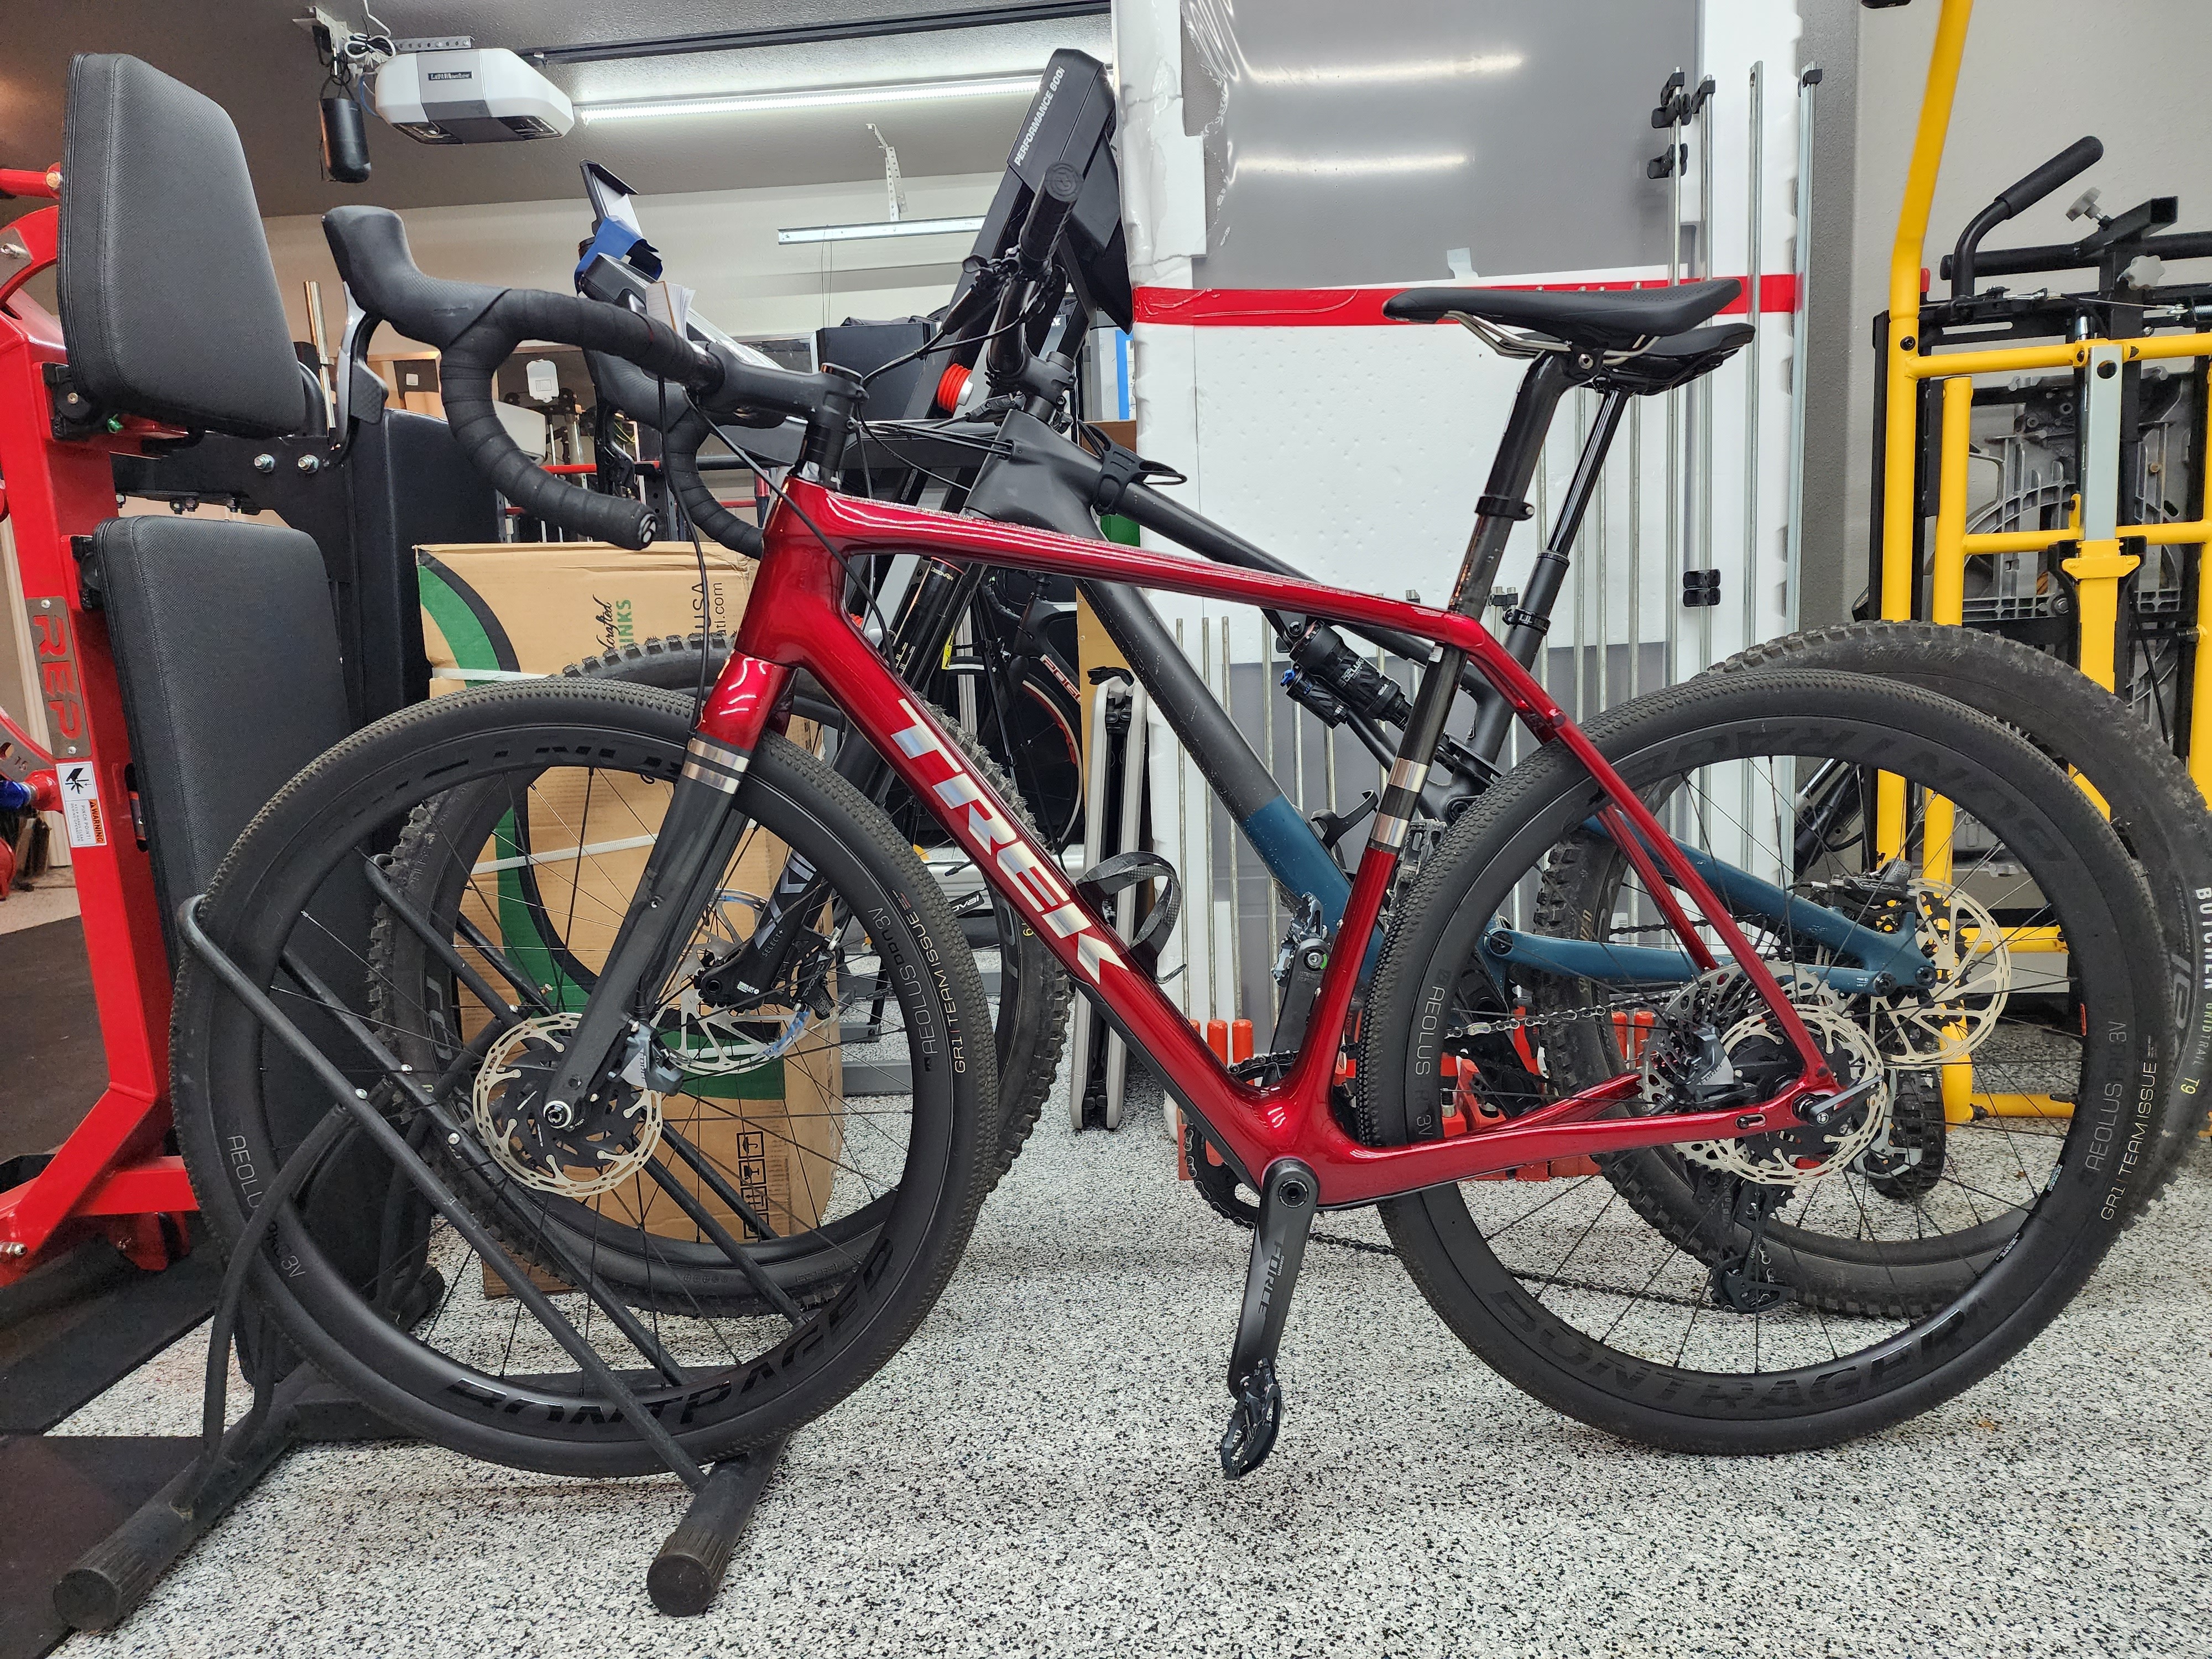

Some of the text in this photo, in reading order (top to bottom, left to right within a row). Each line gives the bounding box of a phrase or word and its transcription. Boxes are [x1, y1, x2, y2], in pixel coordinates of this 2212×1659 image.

[1014, 66, 1066, 167] PERFORMANCE 600i
[615, 599, 634, 649] INKS
[33, 614, 82, 740] REP
[91, 808, 104, 842] WARNING
[890, 699, 1129, 985] TREK
[868, 907, 891, 930] 3V
[905, 910, 941, 967] ISSUE
[899, 964, 938, 1055] AEOLUS
[934, 969, 957, 1027] TEAM
[1415, 985, 1446, 1075] AEOLUS
[1416, 1114, 1433, 1135] 3V
[2084, 1021, 2127, 1172] AEOLUS 3V
[2118, 1121, 2148, 1176] TEAM
[2136, 1062, 2157, 1119] ISSUE
[2180, 1077, 2200, 1095] T9
[227, 1135, 306, 1278] AEOLU 3V
[1258, 1240, 1285, 1315] FORCE
